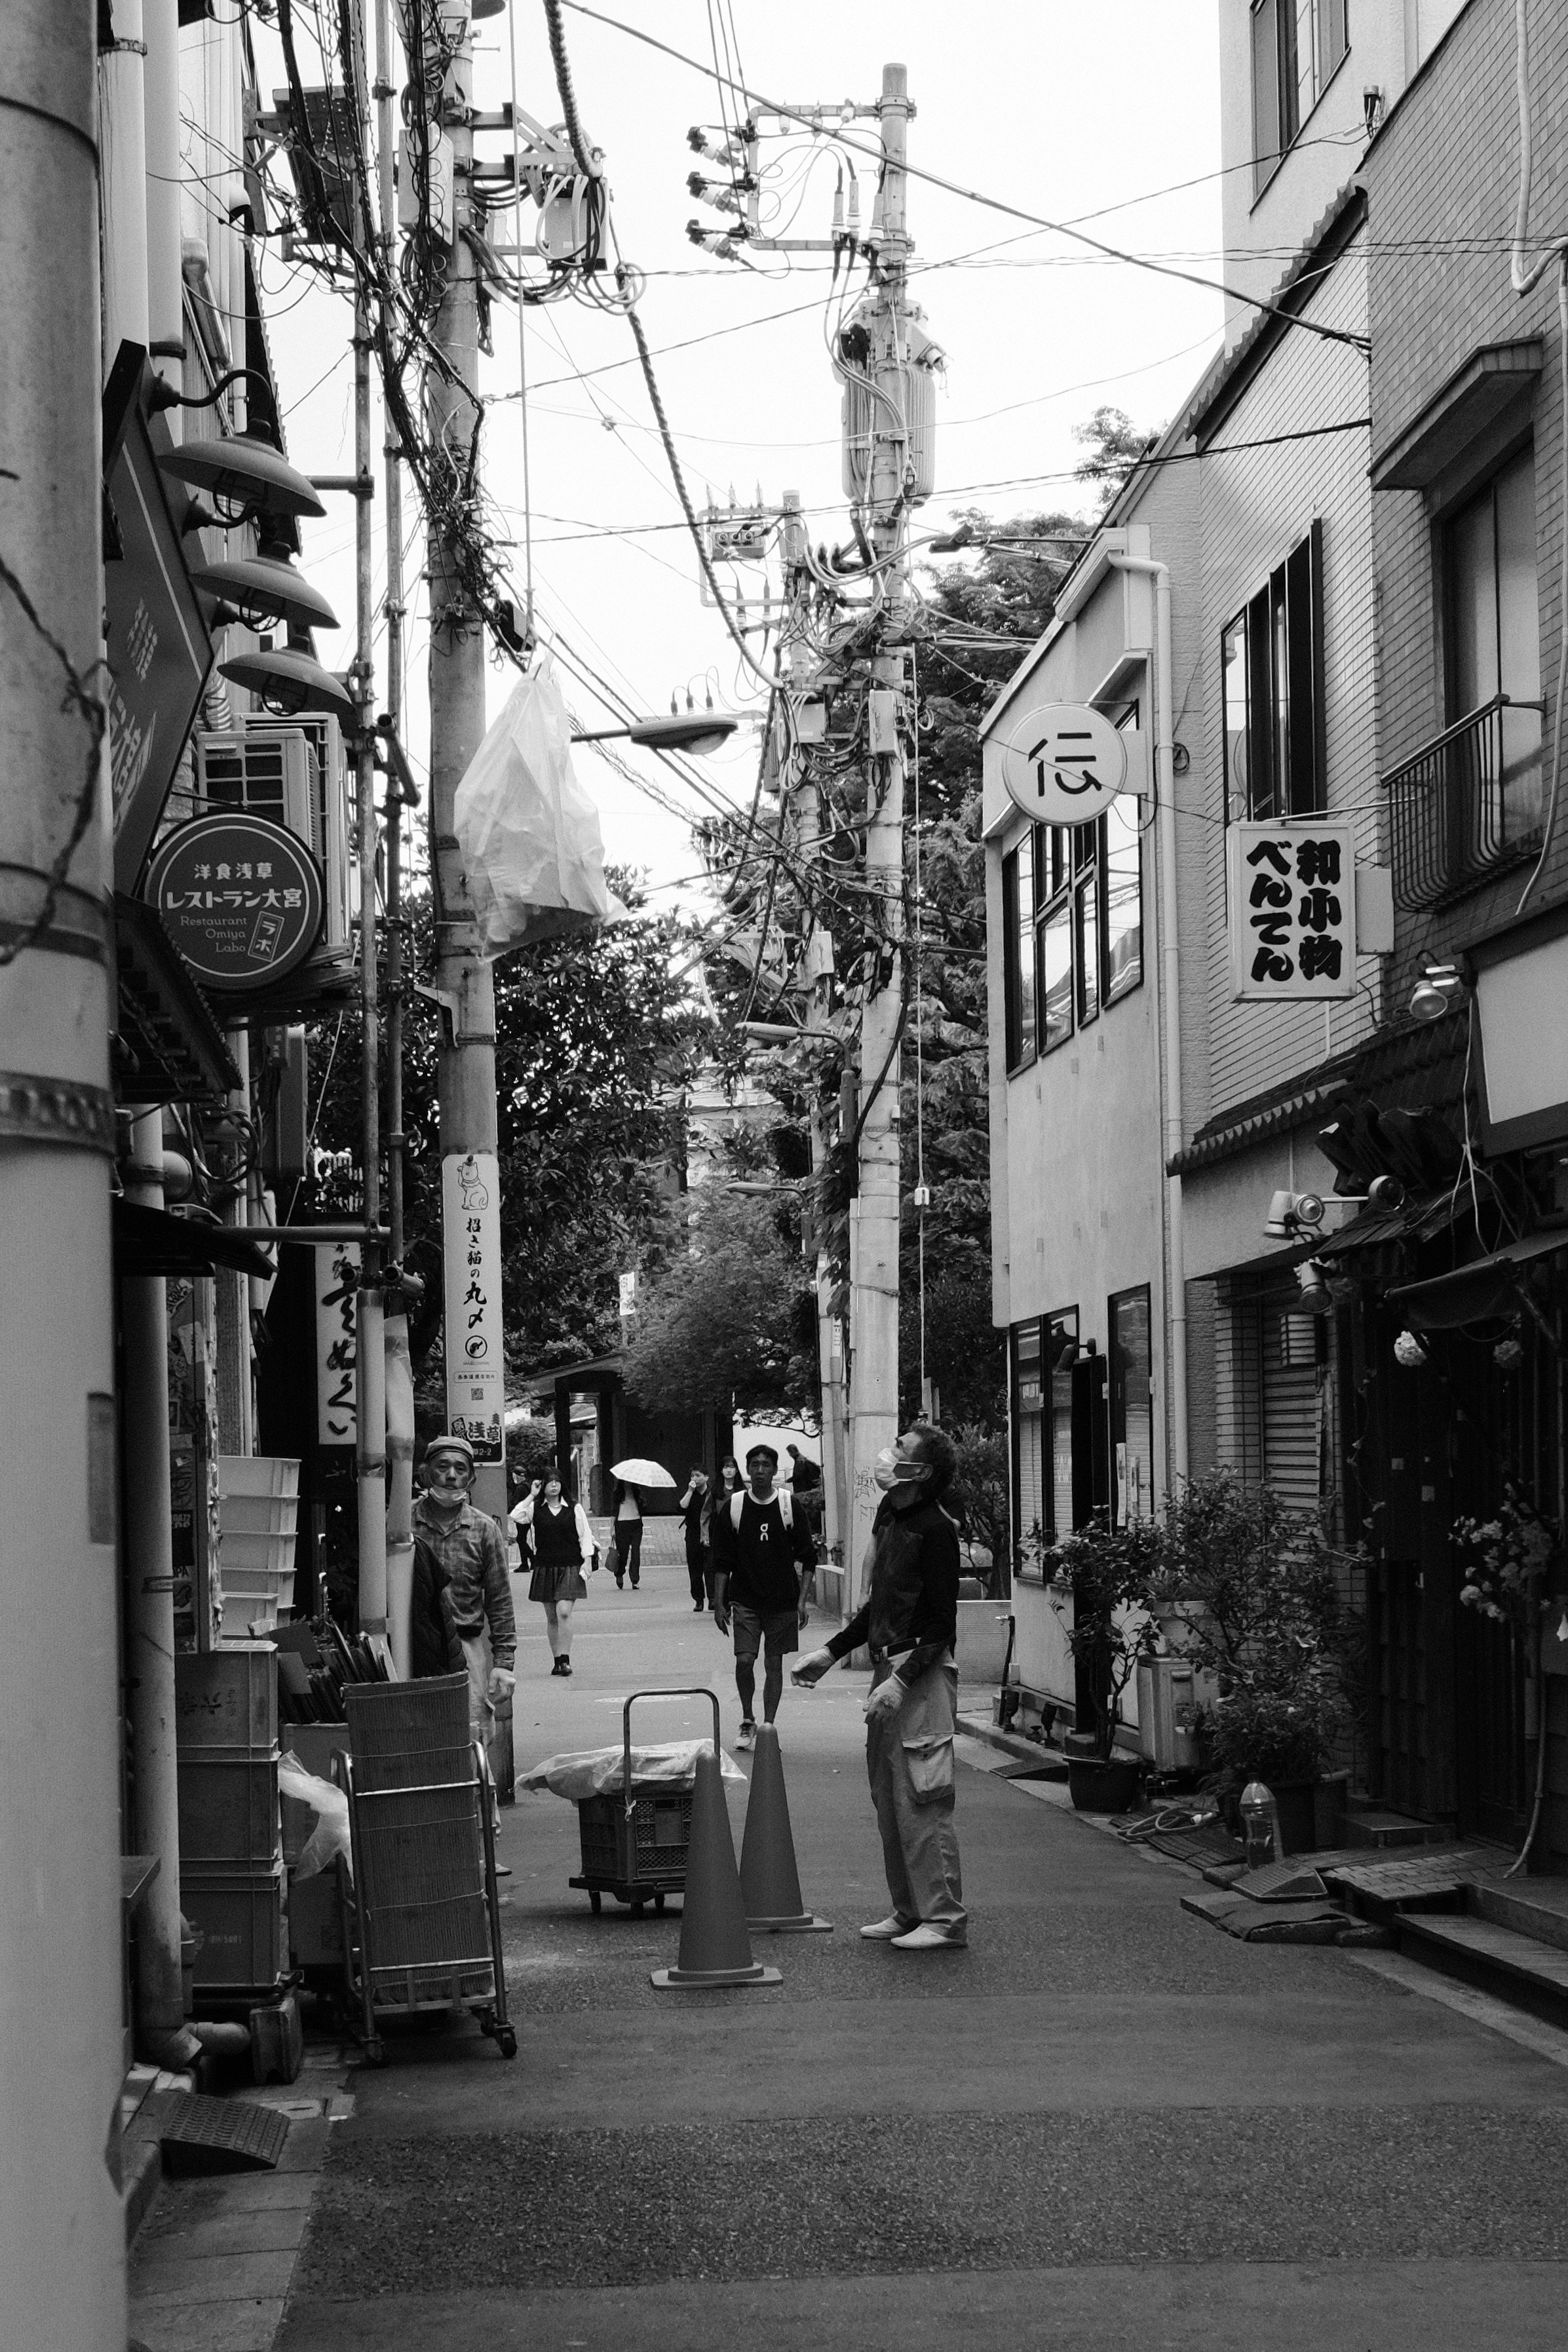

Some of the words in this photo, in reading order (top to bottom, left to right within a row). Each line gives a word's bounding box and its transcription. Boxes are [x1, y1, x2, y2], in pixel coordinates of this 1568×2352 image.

[194, 862, 273, 879] 洋食浅草
[166, 888, 302, 909] レストラン大宮
[1246, 840, 1294, 982] べんてん
[1297, 839, 1343, 981] 和小物
[181, 916, 247, 926] Restaurant
[205, 928, 246, 941] Omiya
[215, 942, 246, 953] Labo
